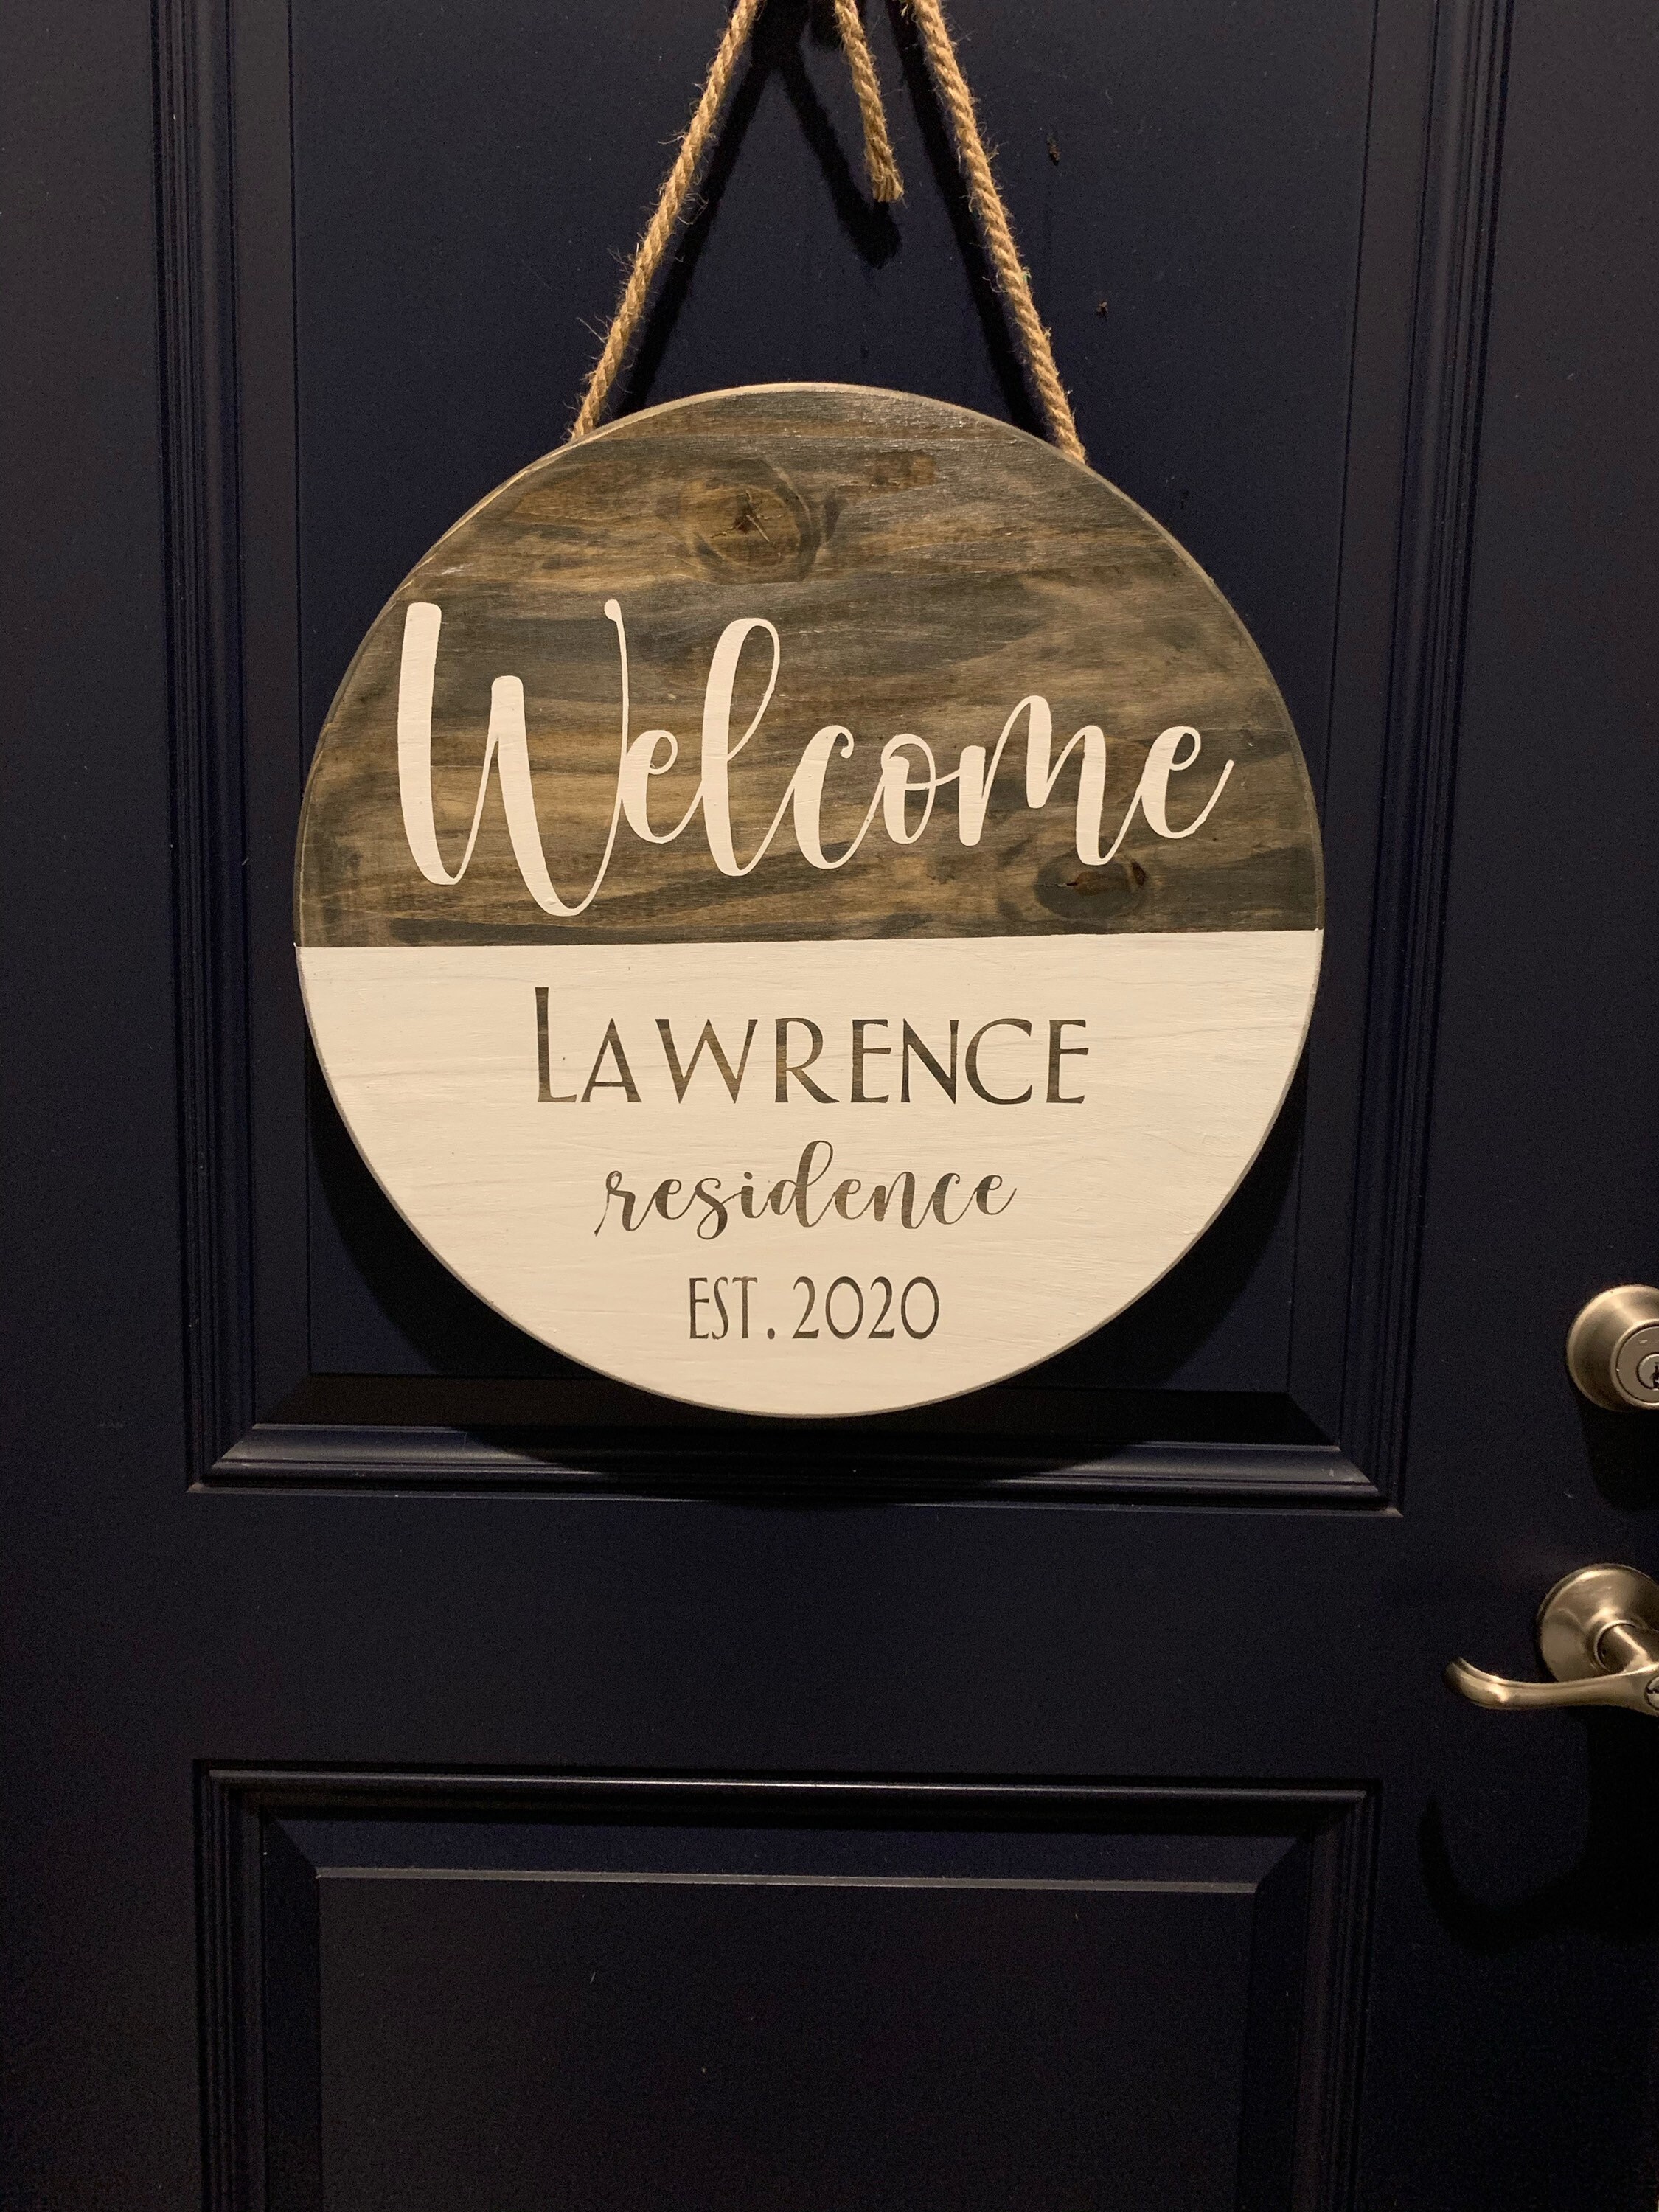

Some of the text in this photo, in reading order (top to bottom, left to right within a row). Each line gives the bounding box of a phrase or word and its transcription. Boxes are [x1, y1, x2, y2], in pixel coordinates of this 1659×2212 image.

[397, 599, 1234, 917] Welcome
[535, 986, 1089, 1105] LAWRENCE
[594, 1139, 1017, 1240] residence
[688, 1276, 940, 1340] EST. 2020
